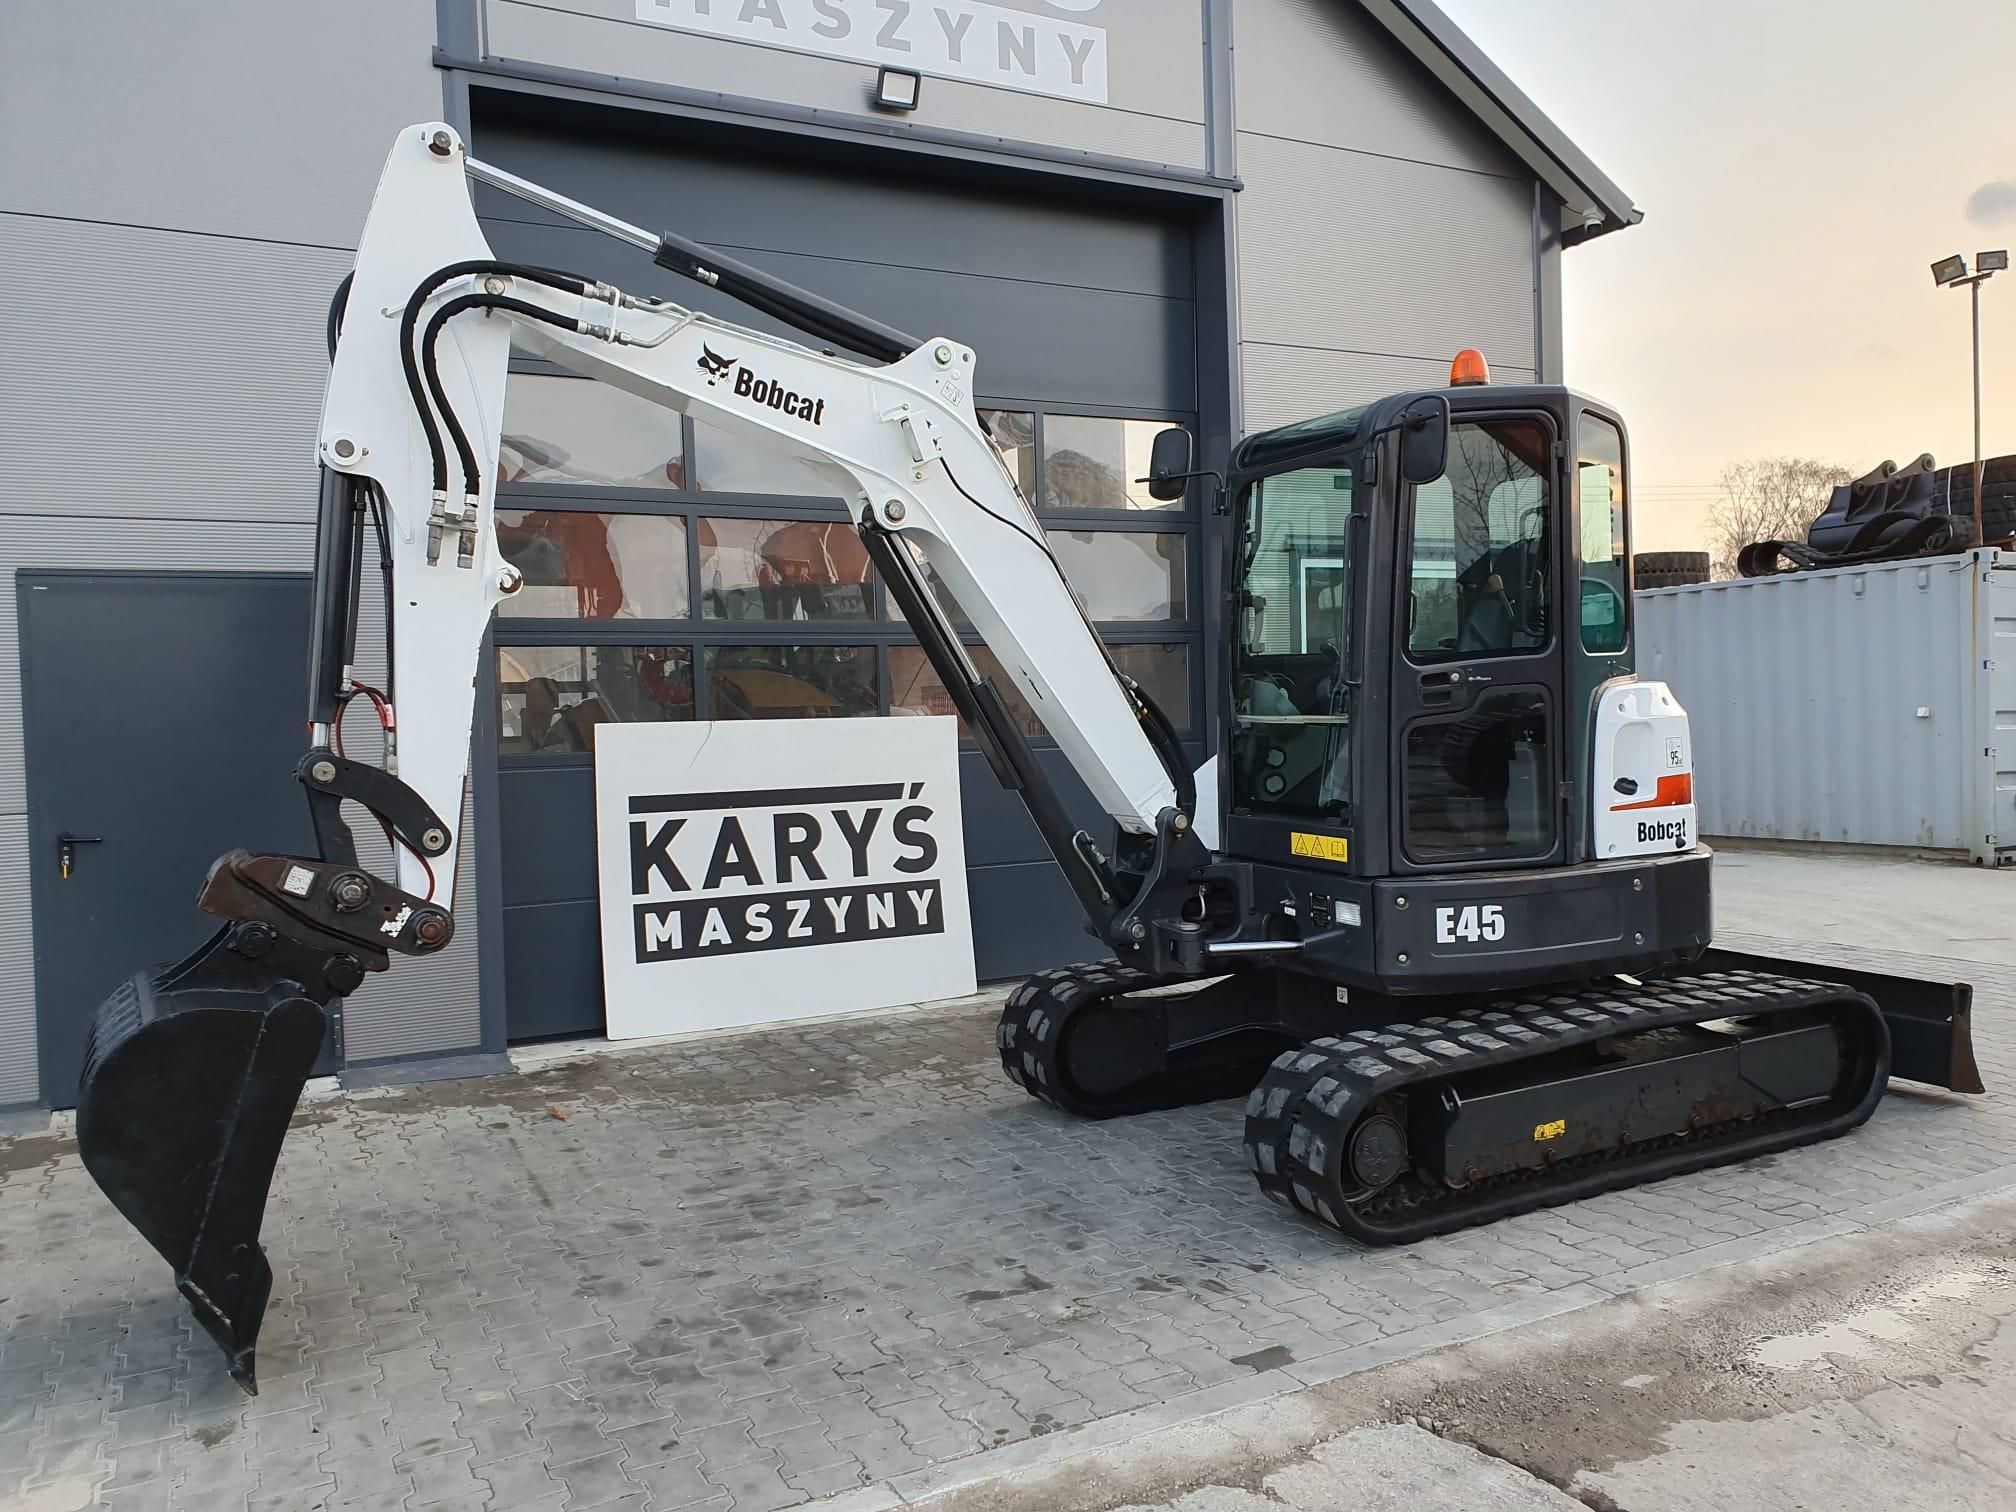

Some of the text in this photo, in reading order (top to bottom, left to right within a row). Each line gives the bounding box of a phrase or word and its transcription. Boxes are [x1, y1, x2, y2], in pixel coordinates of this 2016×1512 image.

[734, 367, 825, 425] Bobcat
[1671, 750, 1679, 765] 95
[629, 782, 938, 895] KARYŚ
[1637, 817, 1686, 842] Bobcat
[645, 888, 934, 952] MASZYNY
[1436, 905, 1505, 944] E45
